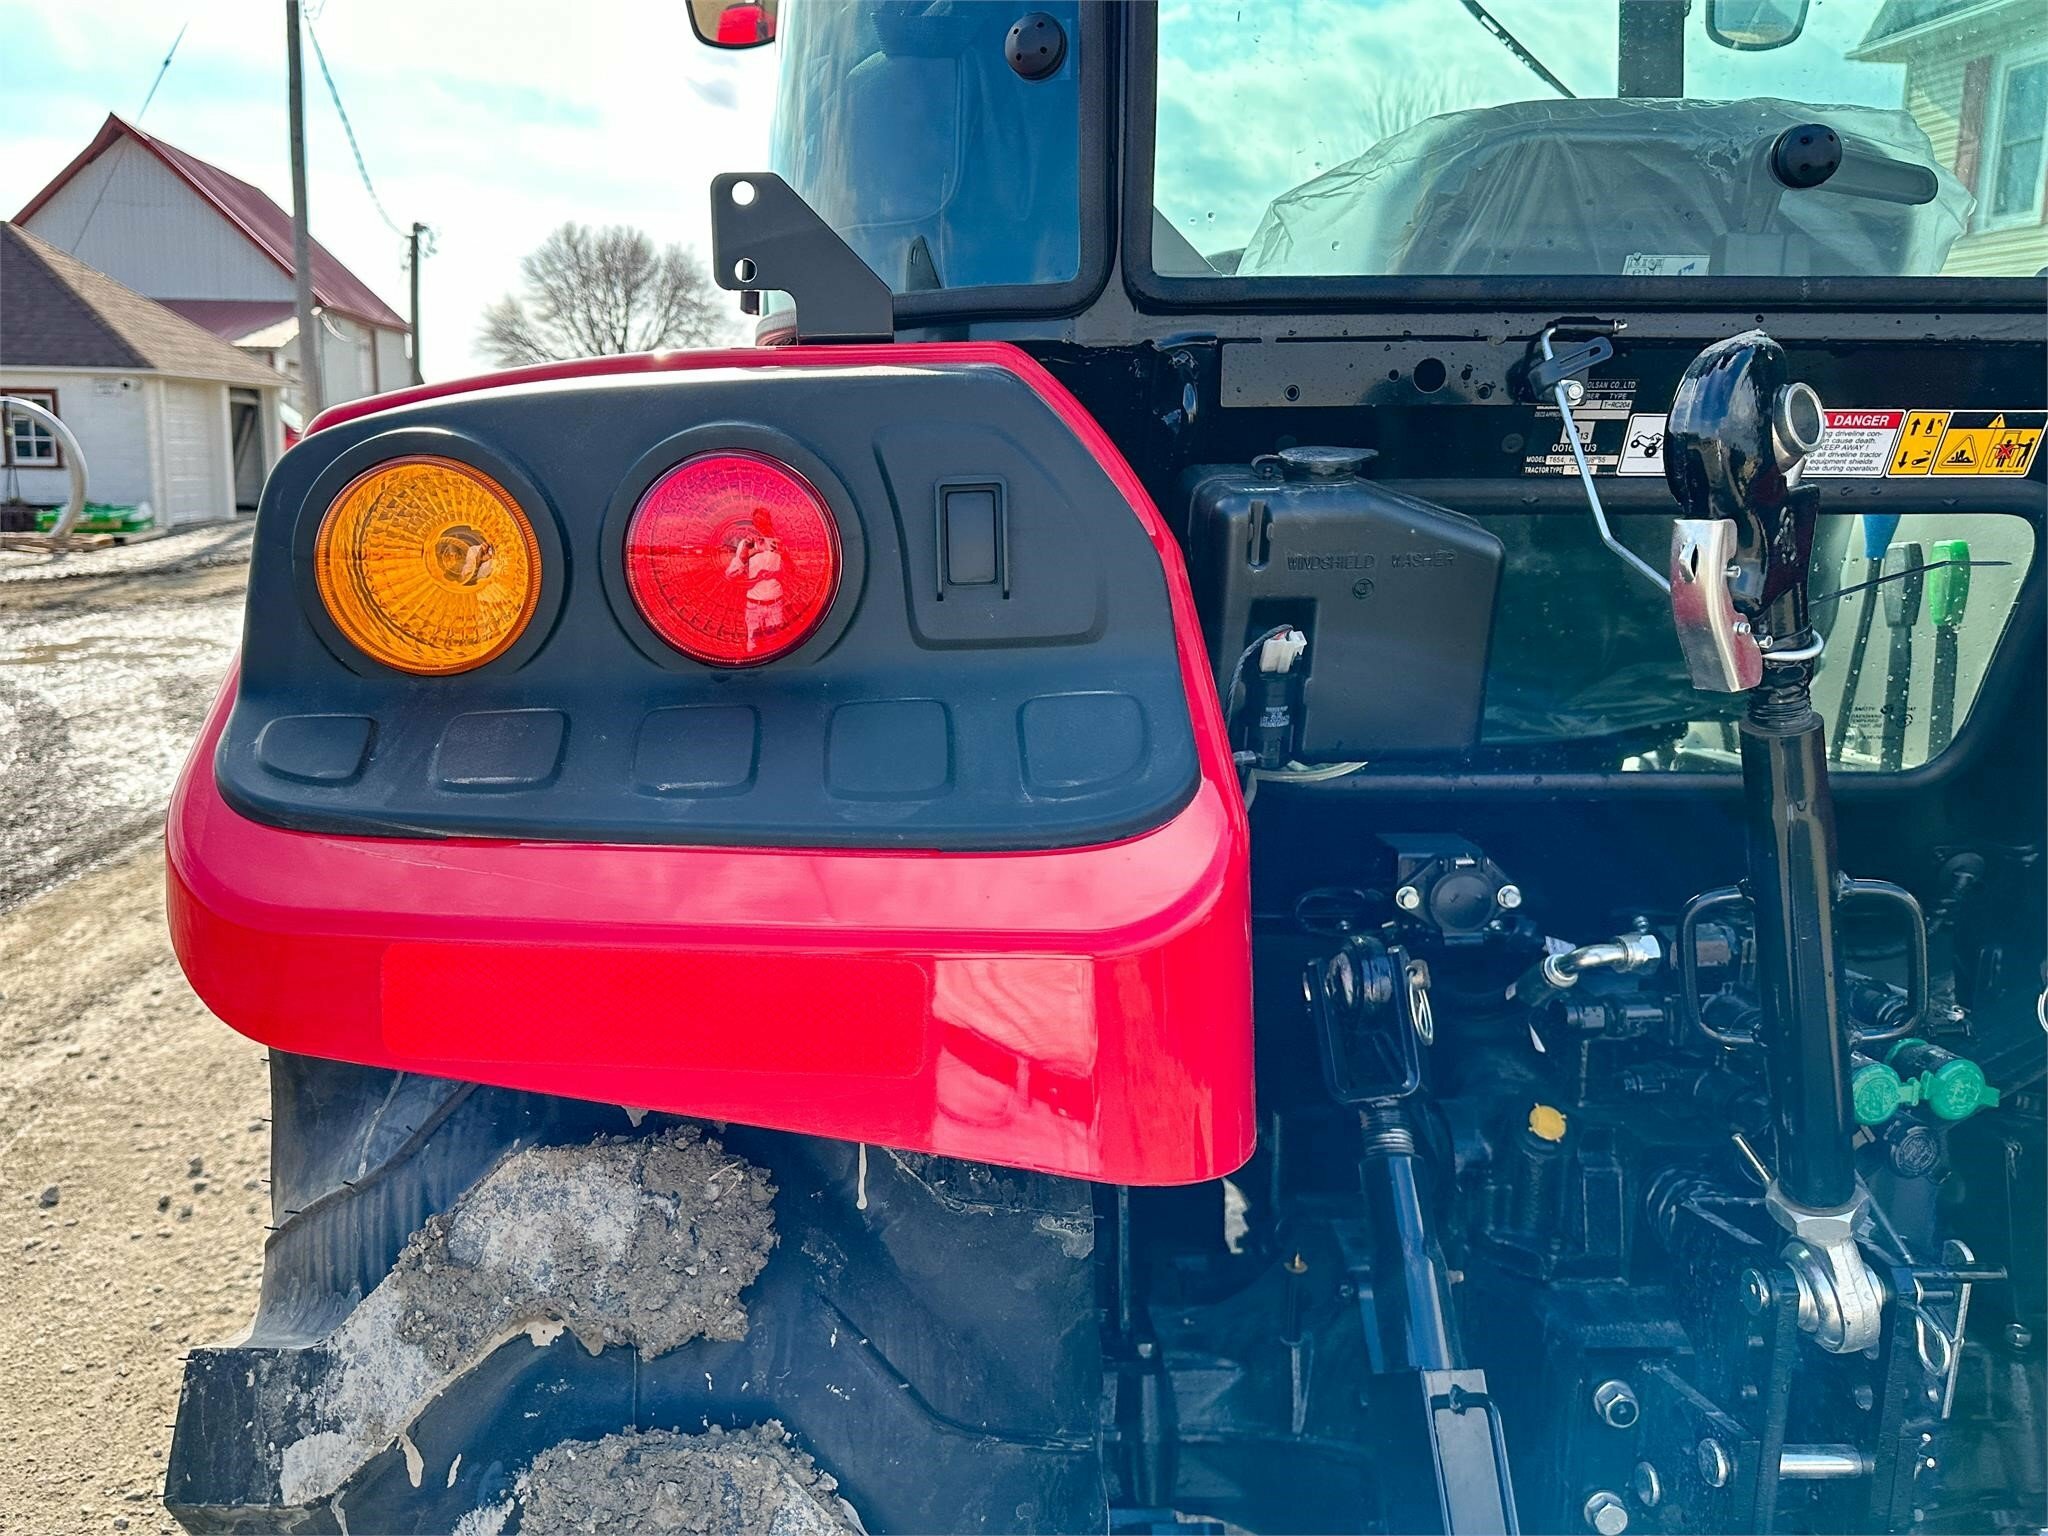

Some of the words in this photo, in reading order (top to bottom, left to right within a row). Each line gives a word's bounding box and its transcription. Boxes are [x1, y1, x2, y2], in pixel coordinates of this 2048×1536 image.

[1833, 415, 1889, 426] DANGER
[1286, 554, 1376, 571] WINDSHIELD
[1391, 551, 1456, 569] WASHER
